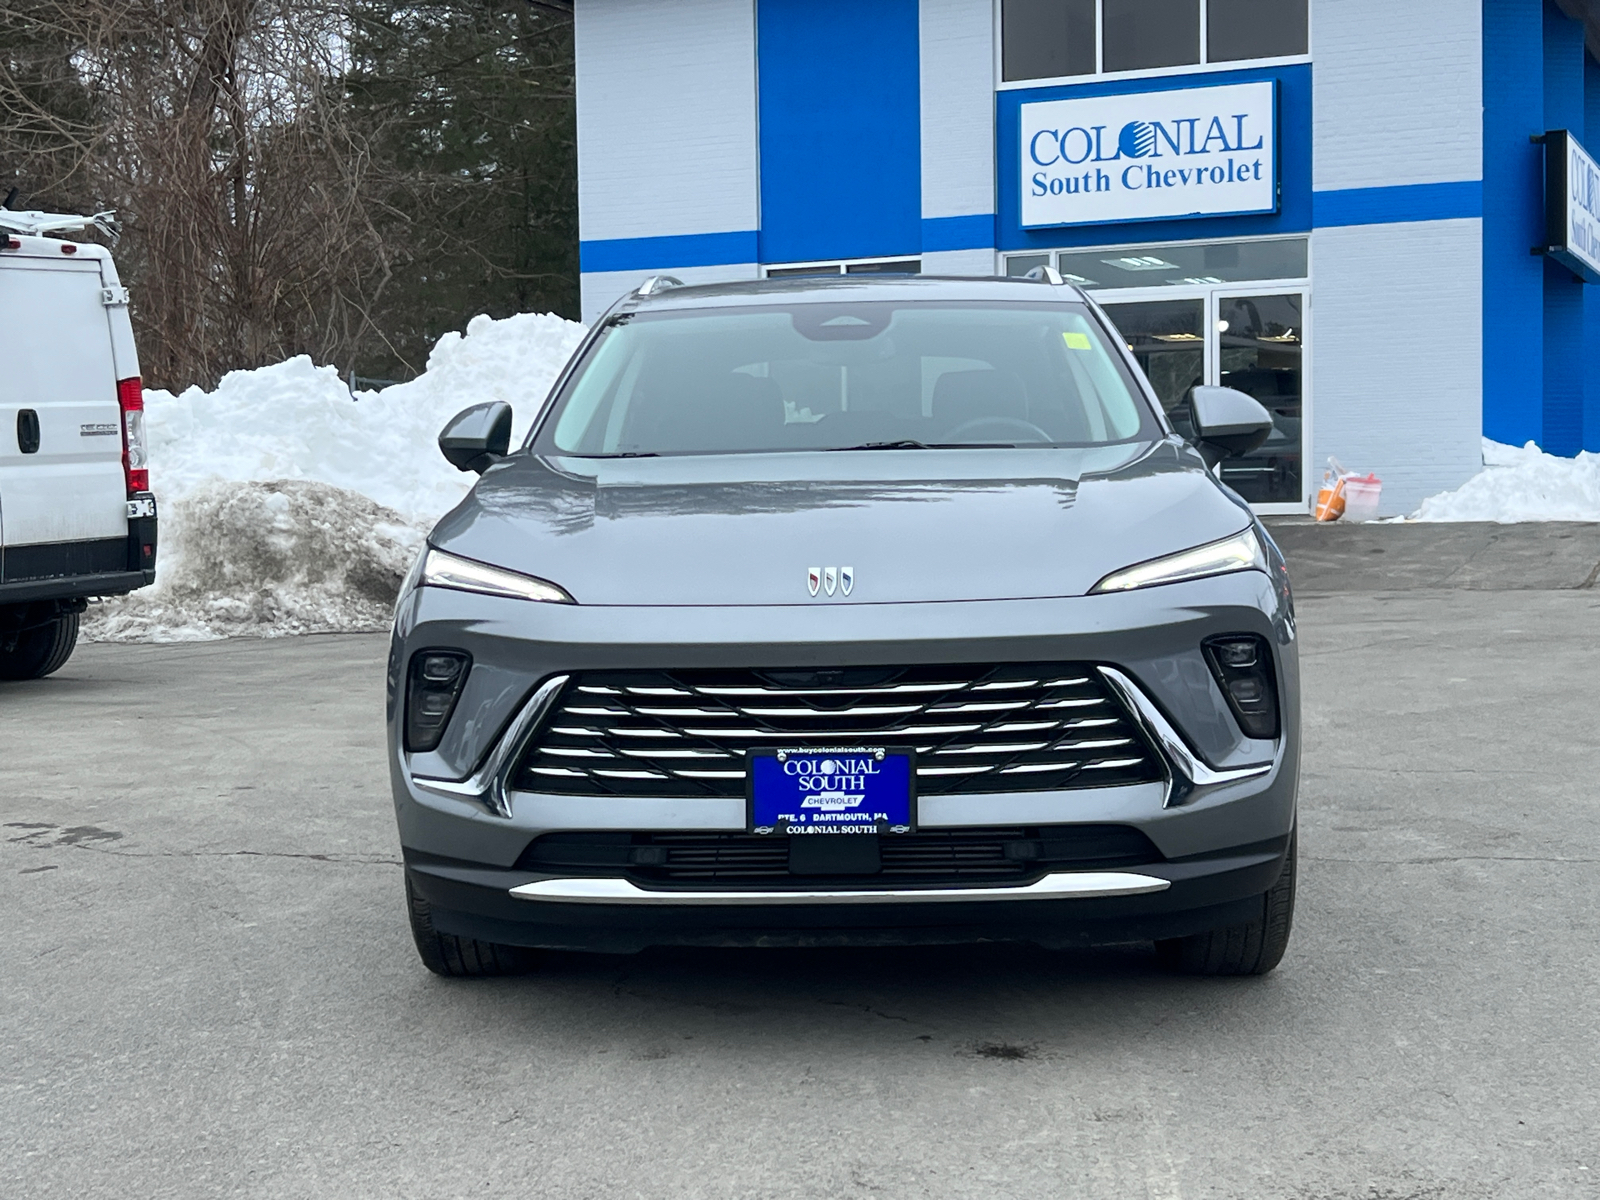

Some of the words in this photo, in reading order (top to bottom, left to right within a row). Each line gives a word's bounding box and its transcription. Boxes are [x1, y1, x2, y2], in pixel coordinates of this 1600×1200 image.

[1030, 114, 1263, 166] COLONIAL
[1032, 168, 1110, 197] South
[1121, 158, 1262, 190] Chevrolet
[784, 760, 880, 775] COLONIAL
[799, 775, 865, 790] SOUTH
[813, 814, 872, 822] DARTMOUTH,
[786, 826, 840, 834] COLONIAL
[841, 826, 877, 834] SOUTH
